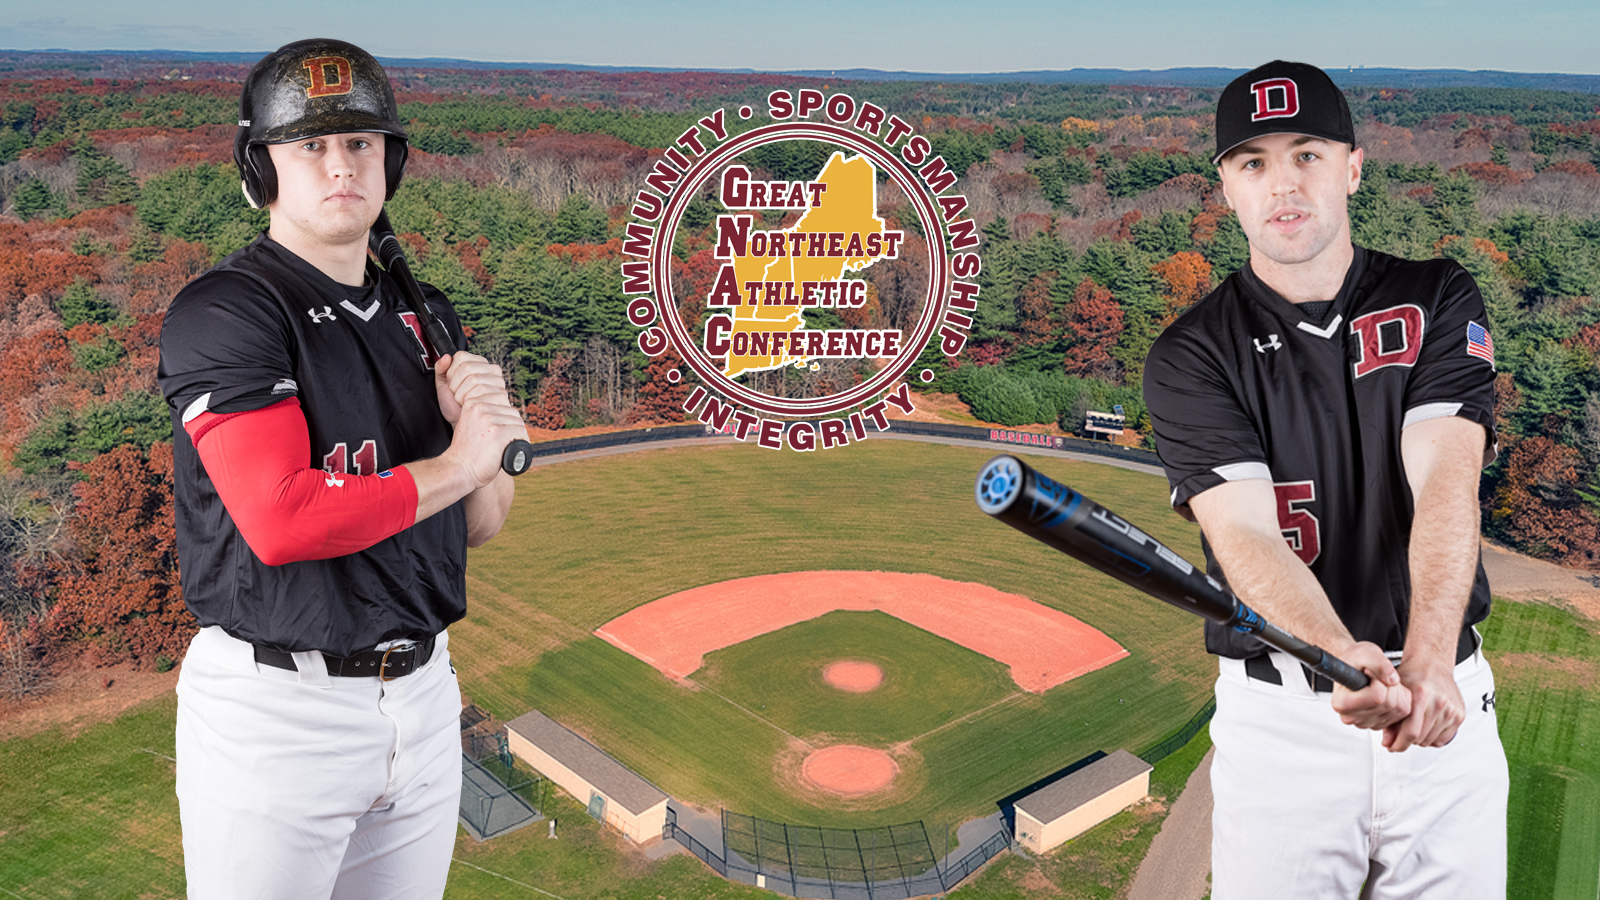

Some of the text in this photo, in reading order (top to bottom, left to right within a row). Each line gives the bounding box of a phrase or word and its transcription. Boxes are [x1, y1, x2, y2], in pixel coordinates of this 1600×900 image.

[302, 56, 353, 99] D
[1250, 77, 1300, 122] D
[1350, 303, 1425, 379] D
[990, 429, 1053, 447] BASEBALL
